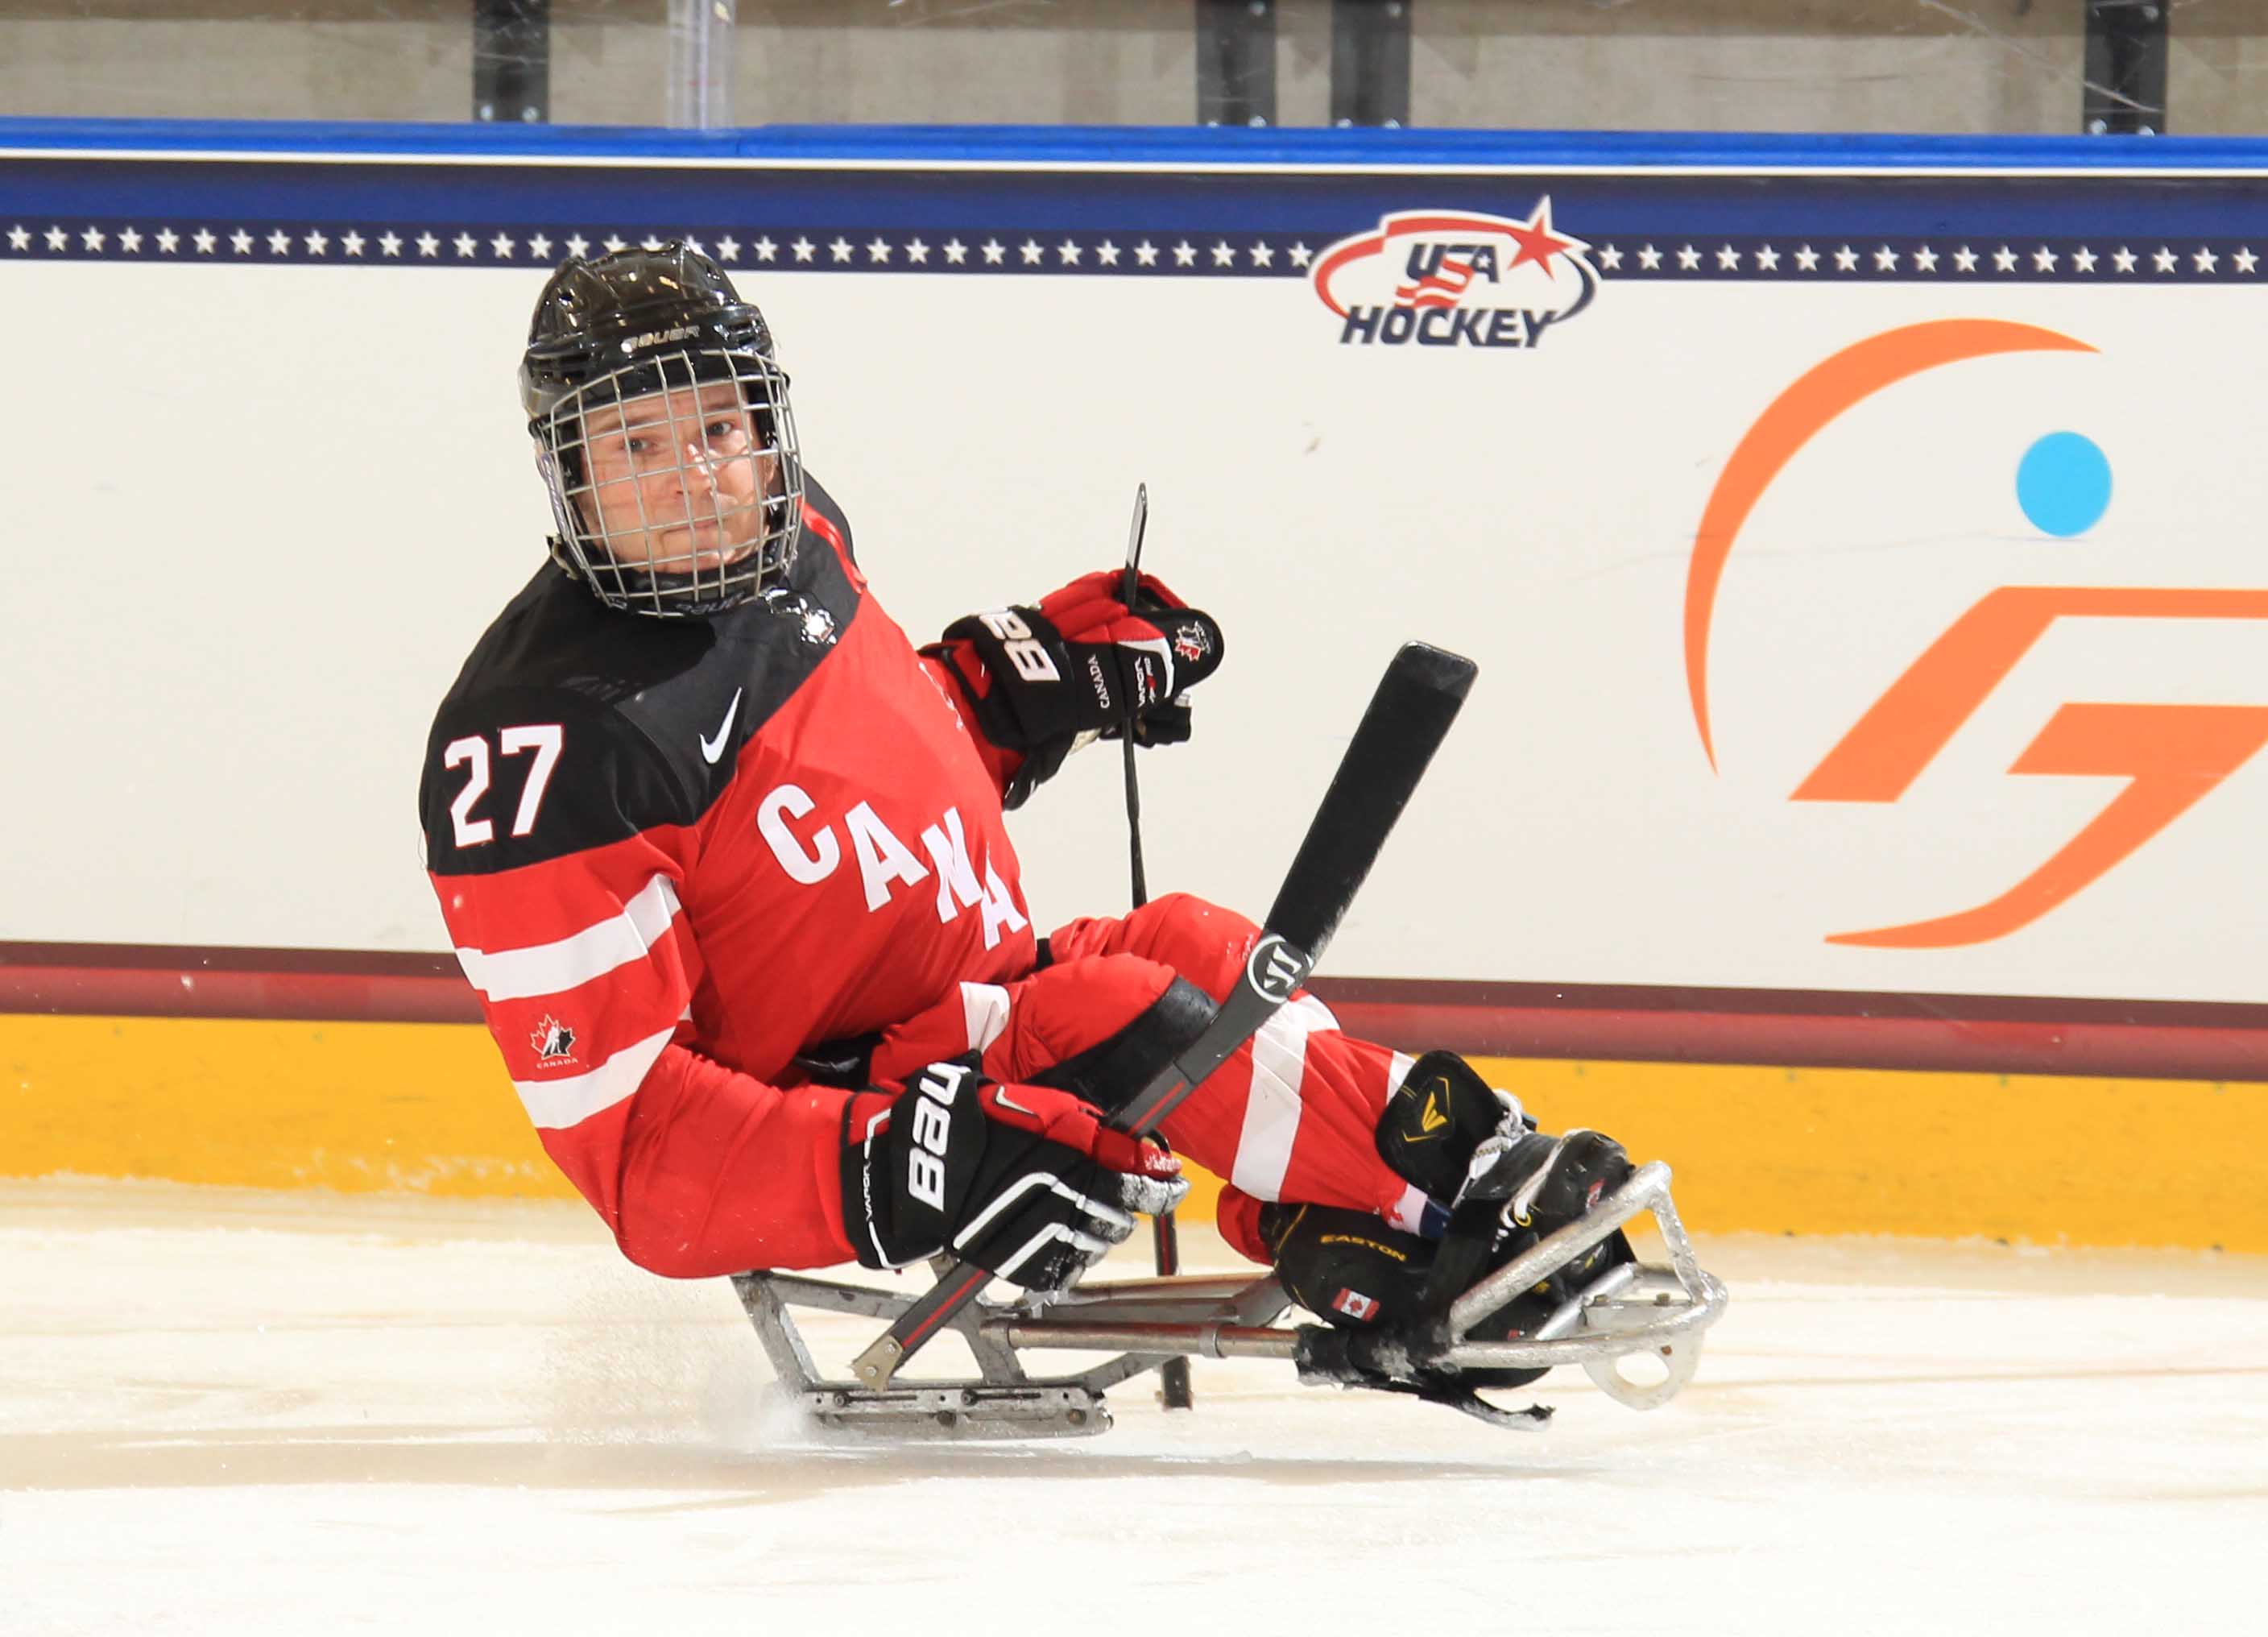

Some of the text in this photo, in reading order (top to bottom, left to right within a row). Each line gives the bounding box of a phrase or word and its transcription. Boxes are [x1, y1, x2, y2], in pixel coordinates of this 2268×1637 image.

[1400, 242, 1500, 300] USA
[1339, 305, 1558, 348] HOCKEY
[1087, 653, 1111, 709] CANADA
[1134, 655, 1145, 708] VAPOR
[443, 722, 564, 849] 27
[755, 783, 1028, 951] CANA
[536, 1057, 578, 1070] CANADA
[908, 1061, 972, 1213] BAU
[862, 1161, 873, 1222] VAPOR
[1319, 1233, 1407, 1262] EASTON
